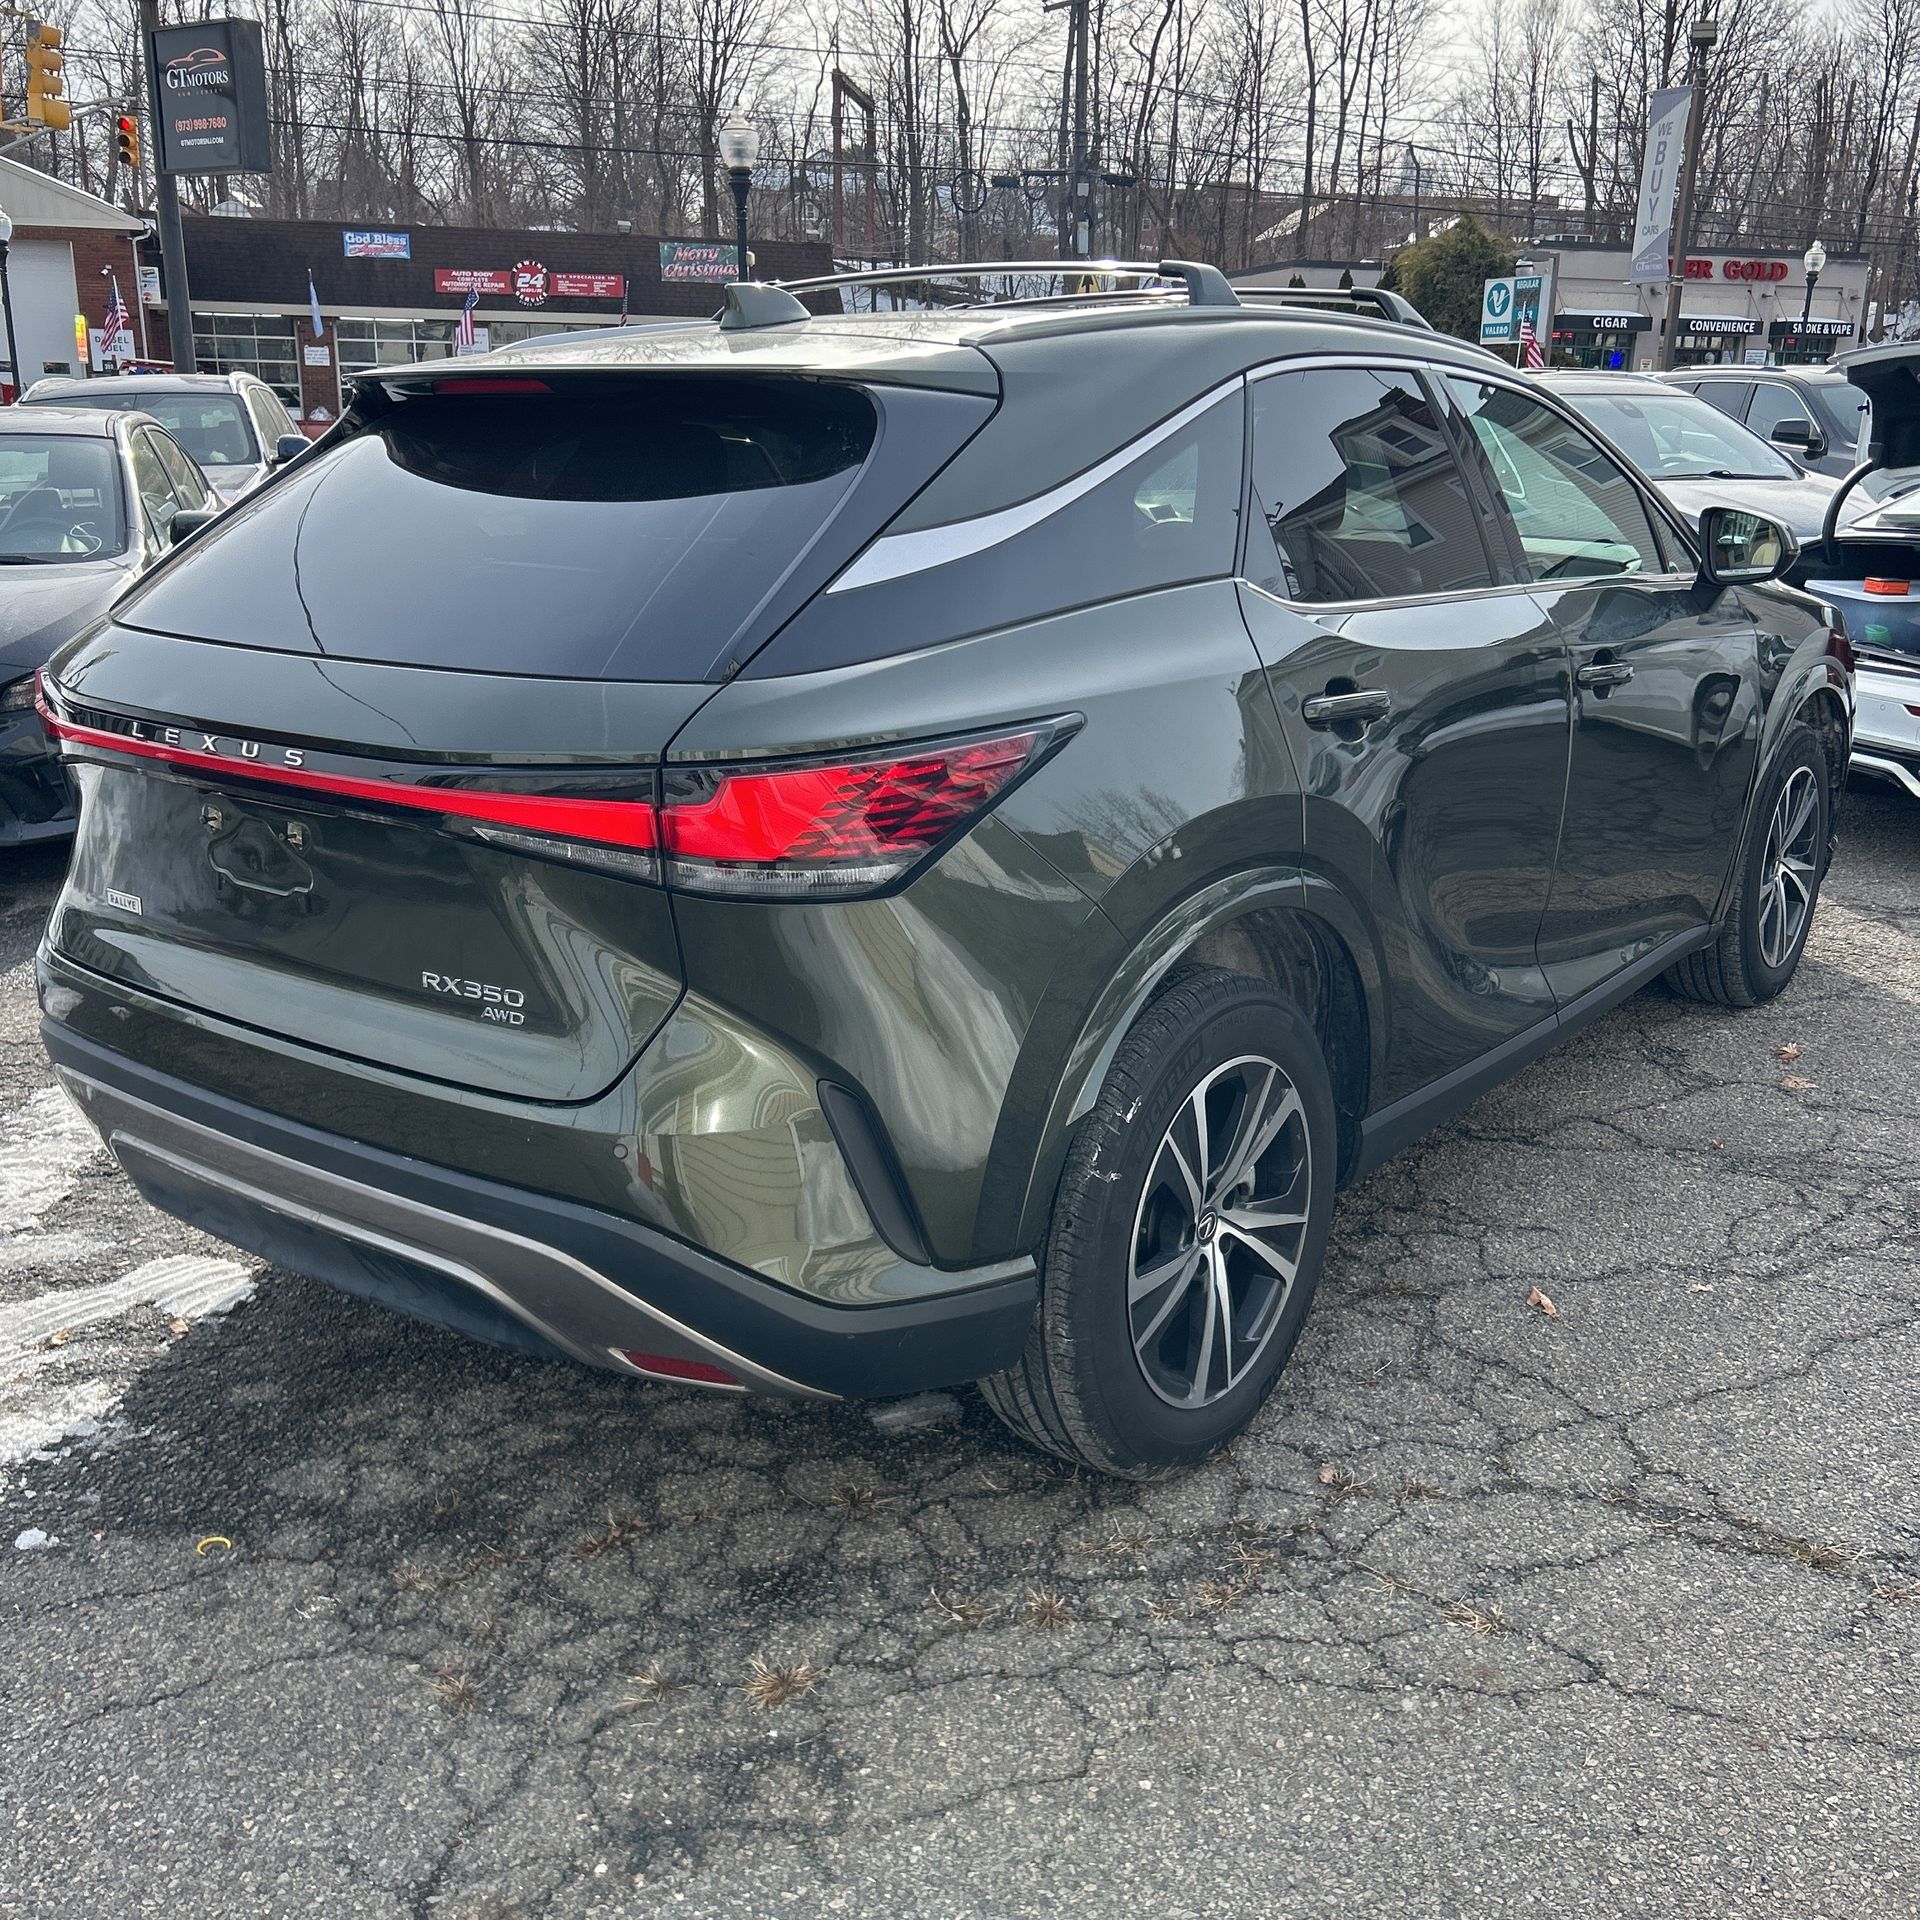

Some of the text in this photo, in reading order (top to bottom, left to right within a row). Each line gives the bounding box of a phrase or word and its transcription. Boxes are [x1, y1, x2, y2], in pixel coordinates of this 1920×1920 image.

[175, 116, 227, 133] (973) 998-7680
[1657, 121, 1674, 137] WE
[345, 232, 407, 245] God Bless
[1641, 224, 1660, 237] CARS
[673, 246, 720, 262] Merry
[663, 262, 739, 278] Christmas
[1722, 260, 1789, 282] GOLD
[516, 272, 544, 288] 24
[1516, 279, 1540, 289] REGULAR
[1484, 325, 1509, 335] VALERO
[1592, 316, 1629, 329] CIGAR
[1689, 320, 1756, 333] CONVENIENCE
[1822, 323, 1830, 335] &
[1830, 324, 1852, 335] VAPE
[130, 721, 305, 767] LEXUS
[109, 893, 138, 912] RALLYE
[421, 970, 525, 1008] RX350
[480, 1006, 526, 1026] AWD
